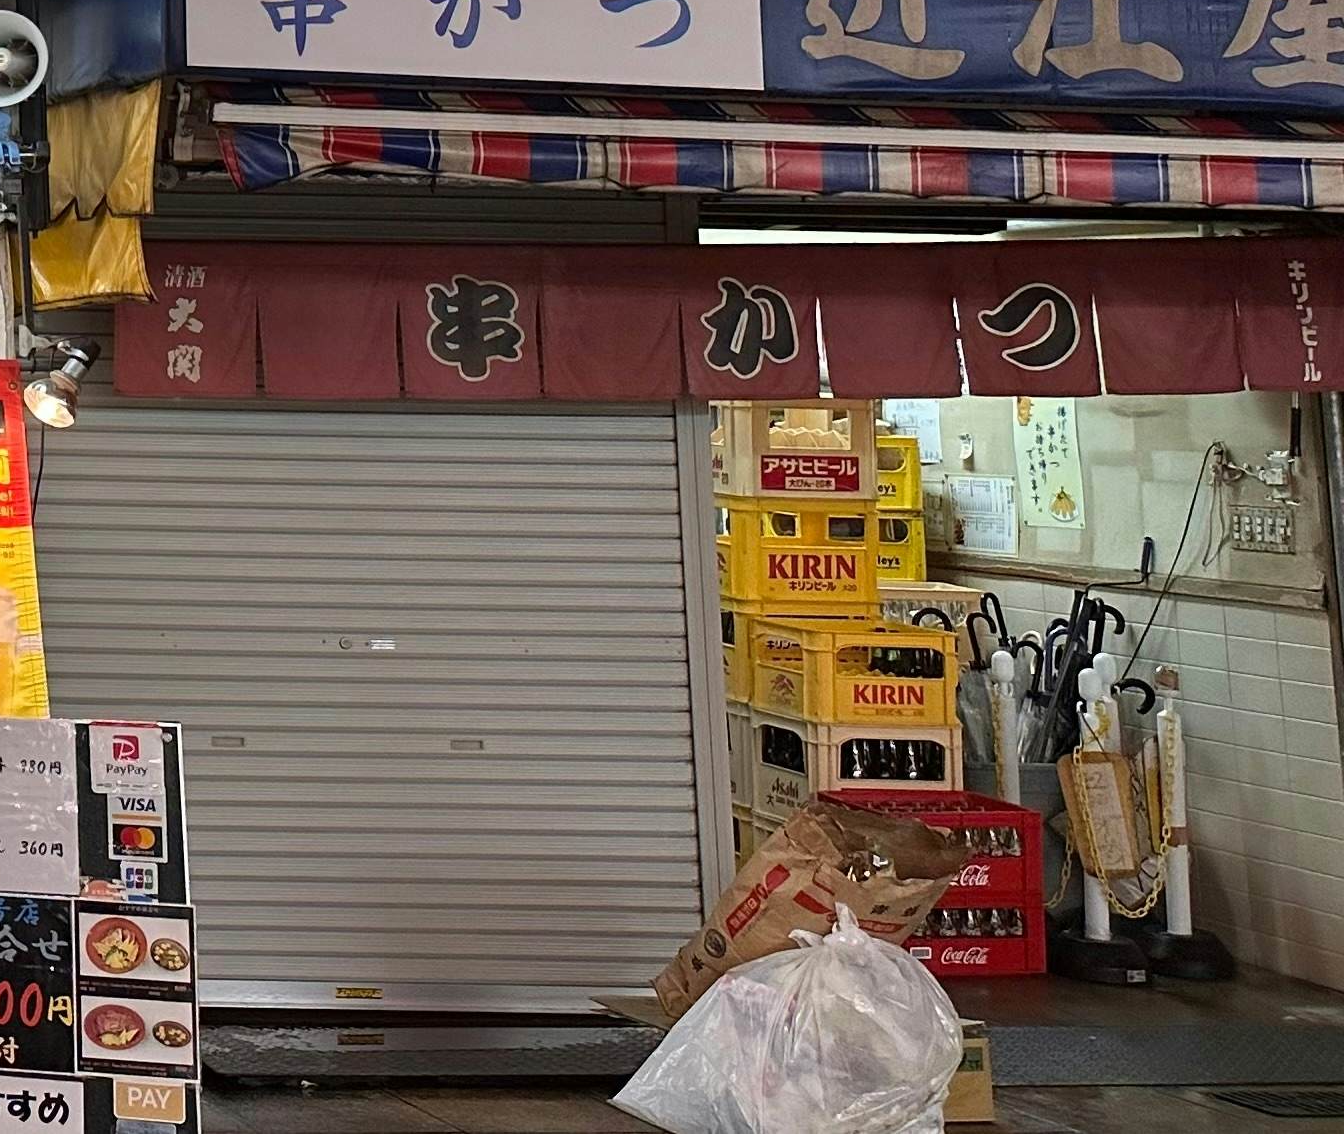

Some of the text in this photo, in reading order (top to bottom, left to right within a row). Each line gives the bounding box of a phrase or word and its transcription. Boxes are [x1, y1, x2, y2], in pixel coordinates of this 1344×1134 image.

[165, 264, 207, 289] 清酒
[425, 272, 1083, 385] 串かつ
[1287, 260, 1322, 382] キリンビール
[763, 456, 857, 476] アサヒビール
[768, 553, 857, 580] KIRIN
[788, 581, 837, 592] キリンビール
[853, 683, 925, 706] KIRIN
[105, 762, 148, 777] PayPay
[771, 777, 799, 800] Asahi
[117, 796, 157, 812] VISA
[18, 839, 64, 858] 360円
[940, 946, 991, 966] Coca-Cola
[127, 1087, 171, 1110] PAY
